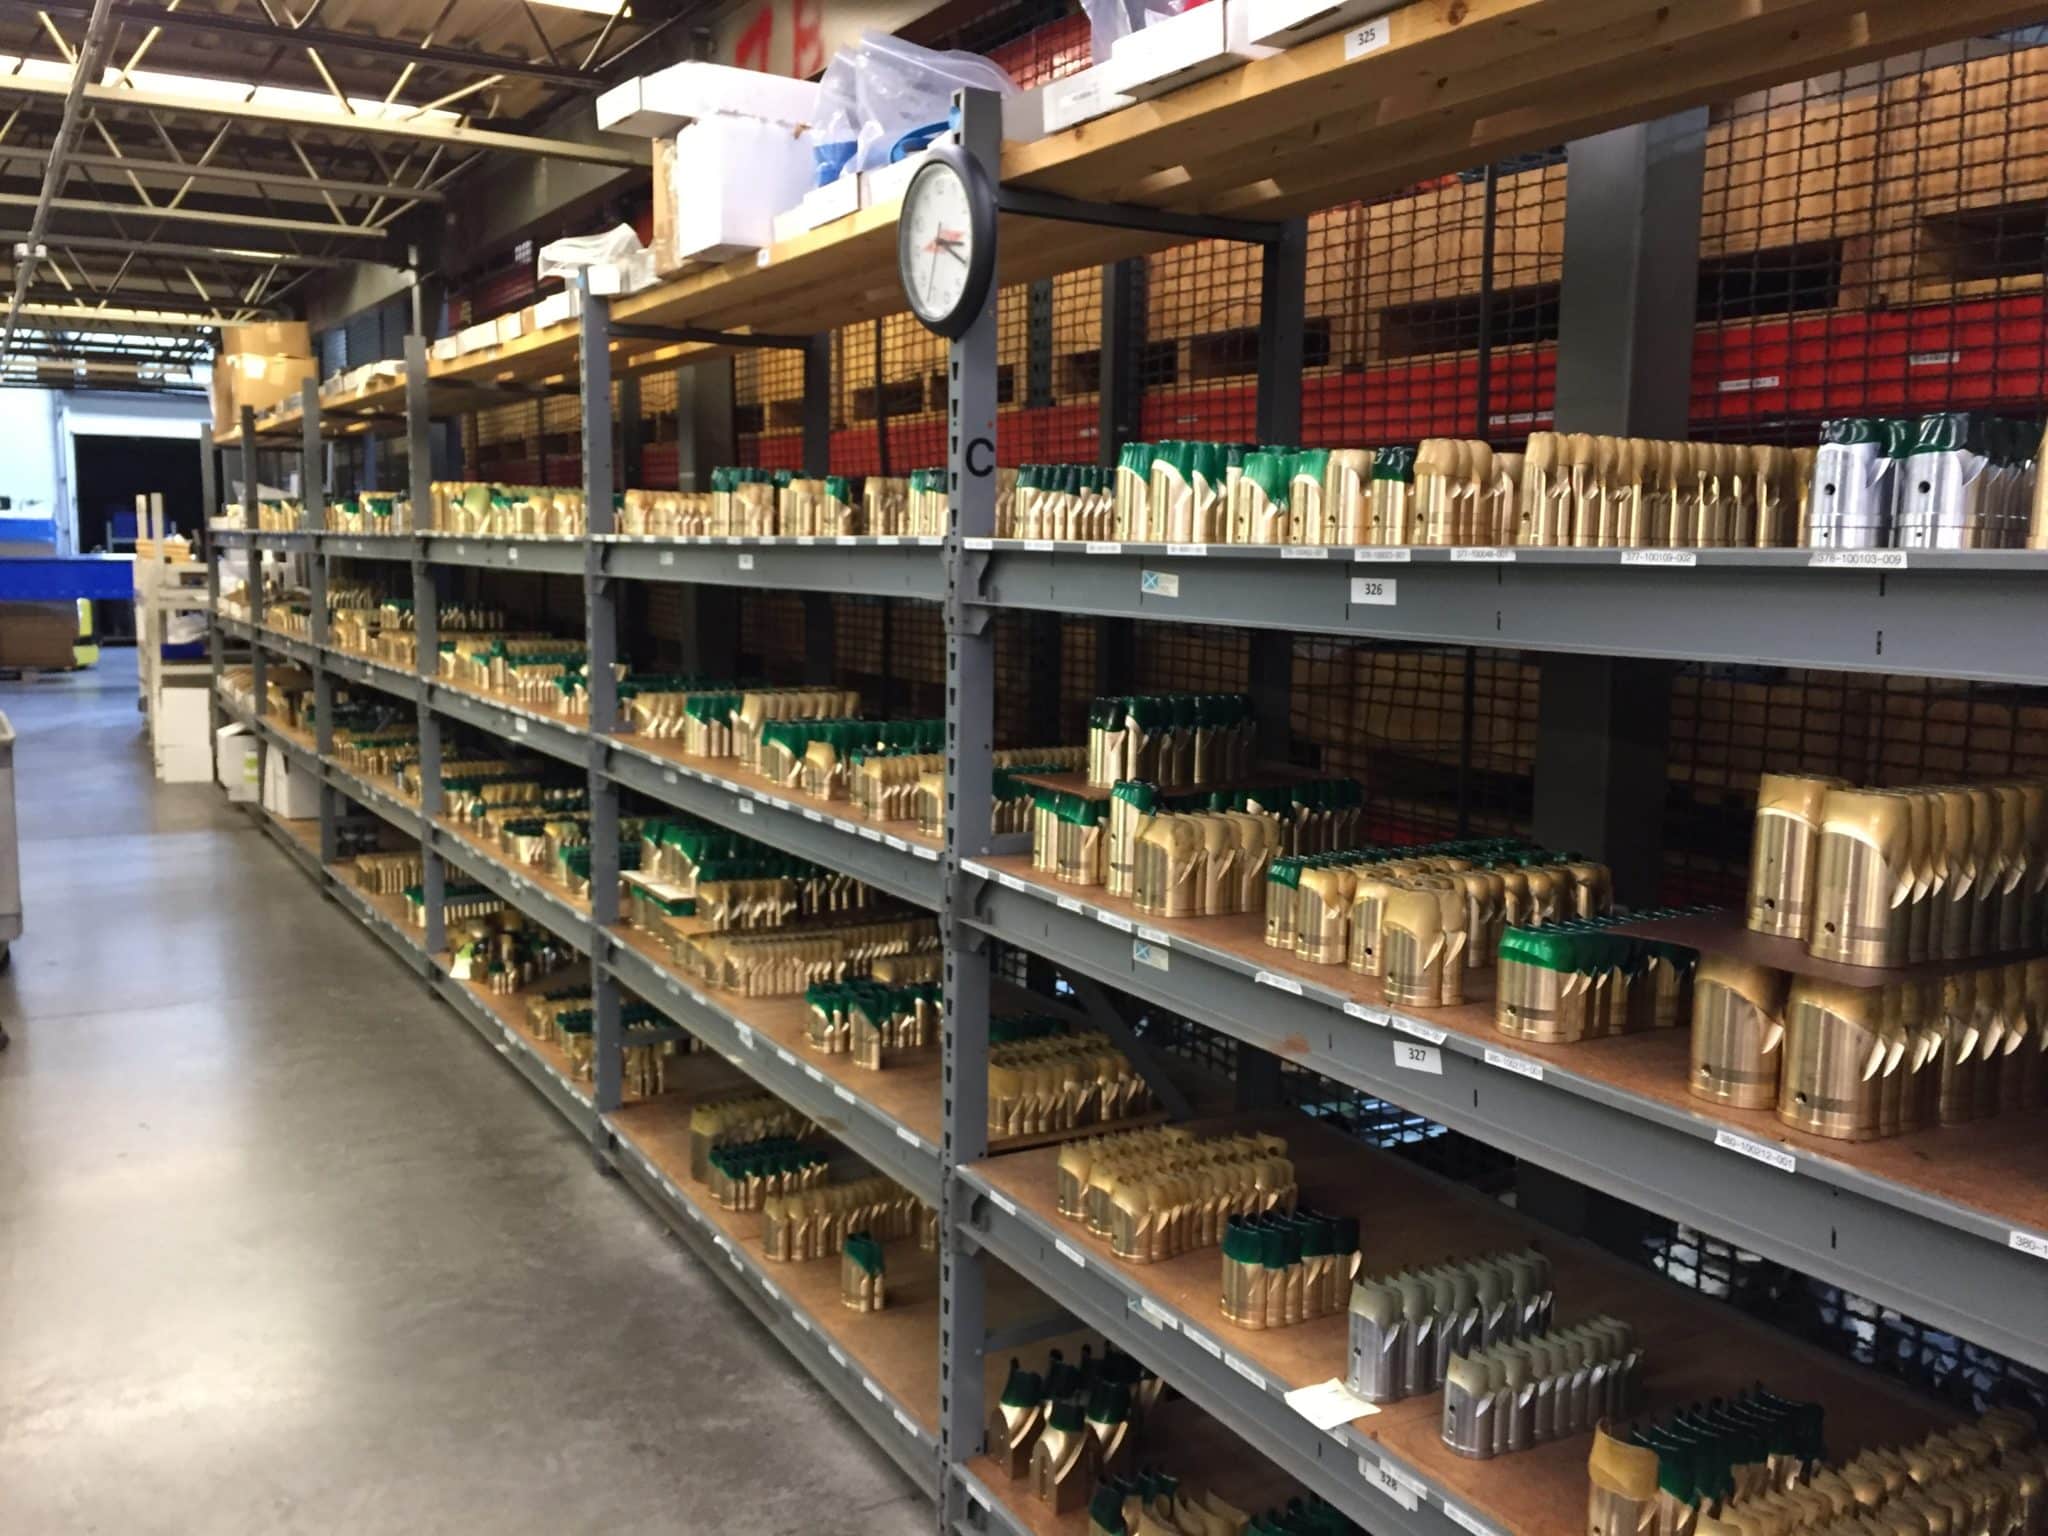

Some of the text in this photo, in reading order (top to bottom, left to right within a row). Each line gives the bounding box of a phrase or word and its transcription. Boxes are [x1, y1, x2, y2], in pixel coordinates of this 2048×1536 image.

[1358, 28, 1376, 46] 325
[965, 437, 995, 478] C
[1365, 583, 1383, 596] 326
[1408, 1047, 1426, 1062] 327
